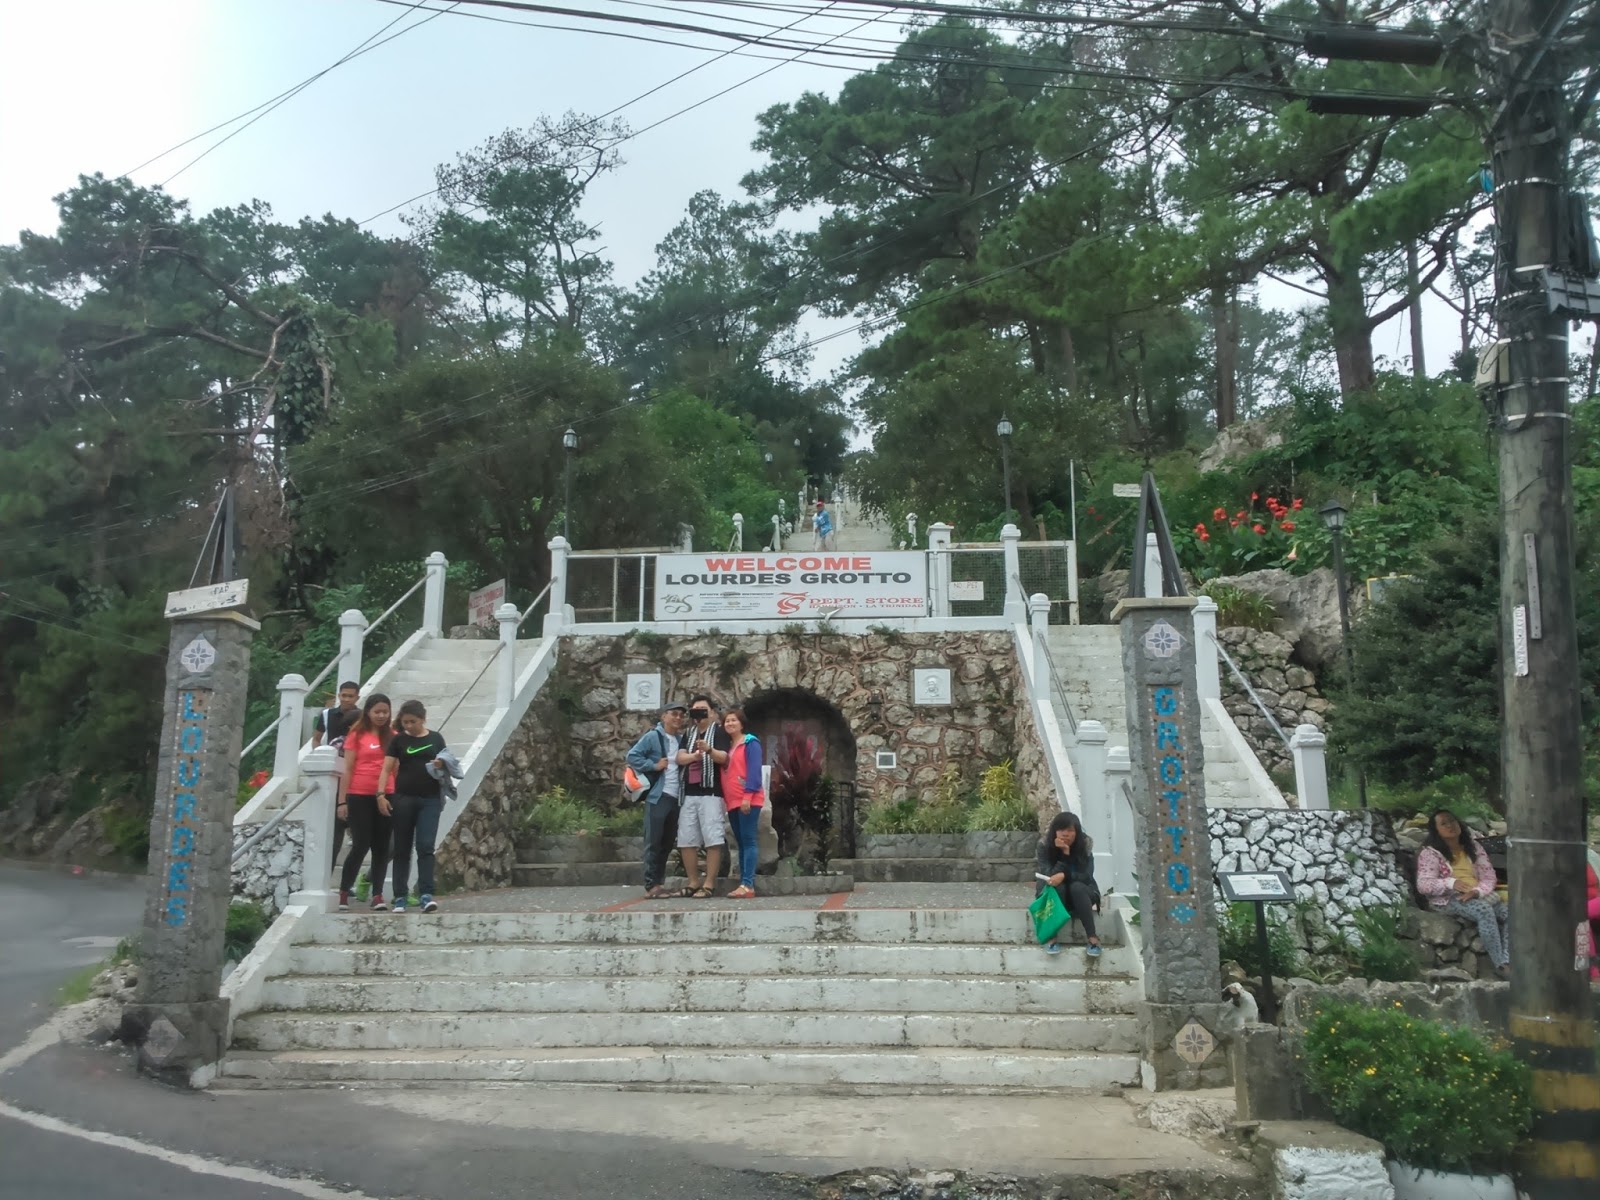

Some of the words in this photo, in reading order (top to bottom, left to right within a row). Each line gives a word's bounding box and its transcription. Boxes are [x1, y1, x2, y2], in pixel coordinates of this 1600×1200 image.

[665, 573, 792, 585] LOURDES
[800, 572, 912, 584] GROTTO
[705, 556, 872, 572] WELCOME
[166, 692, 205, 926] LOURDES
[1154, 687, 1191, 892] GROTTO
